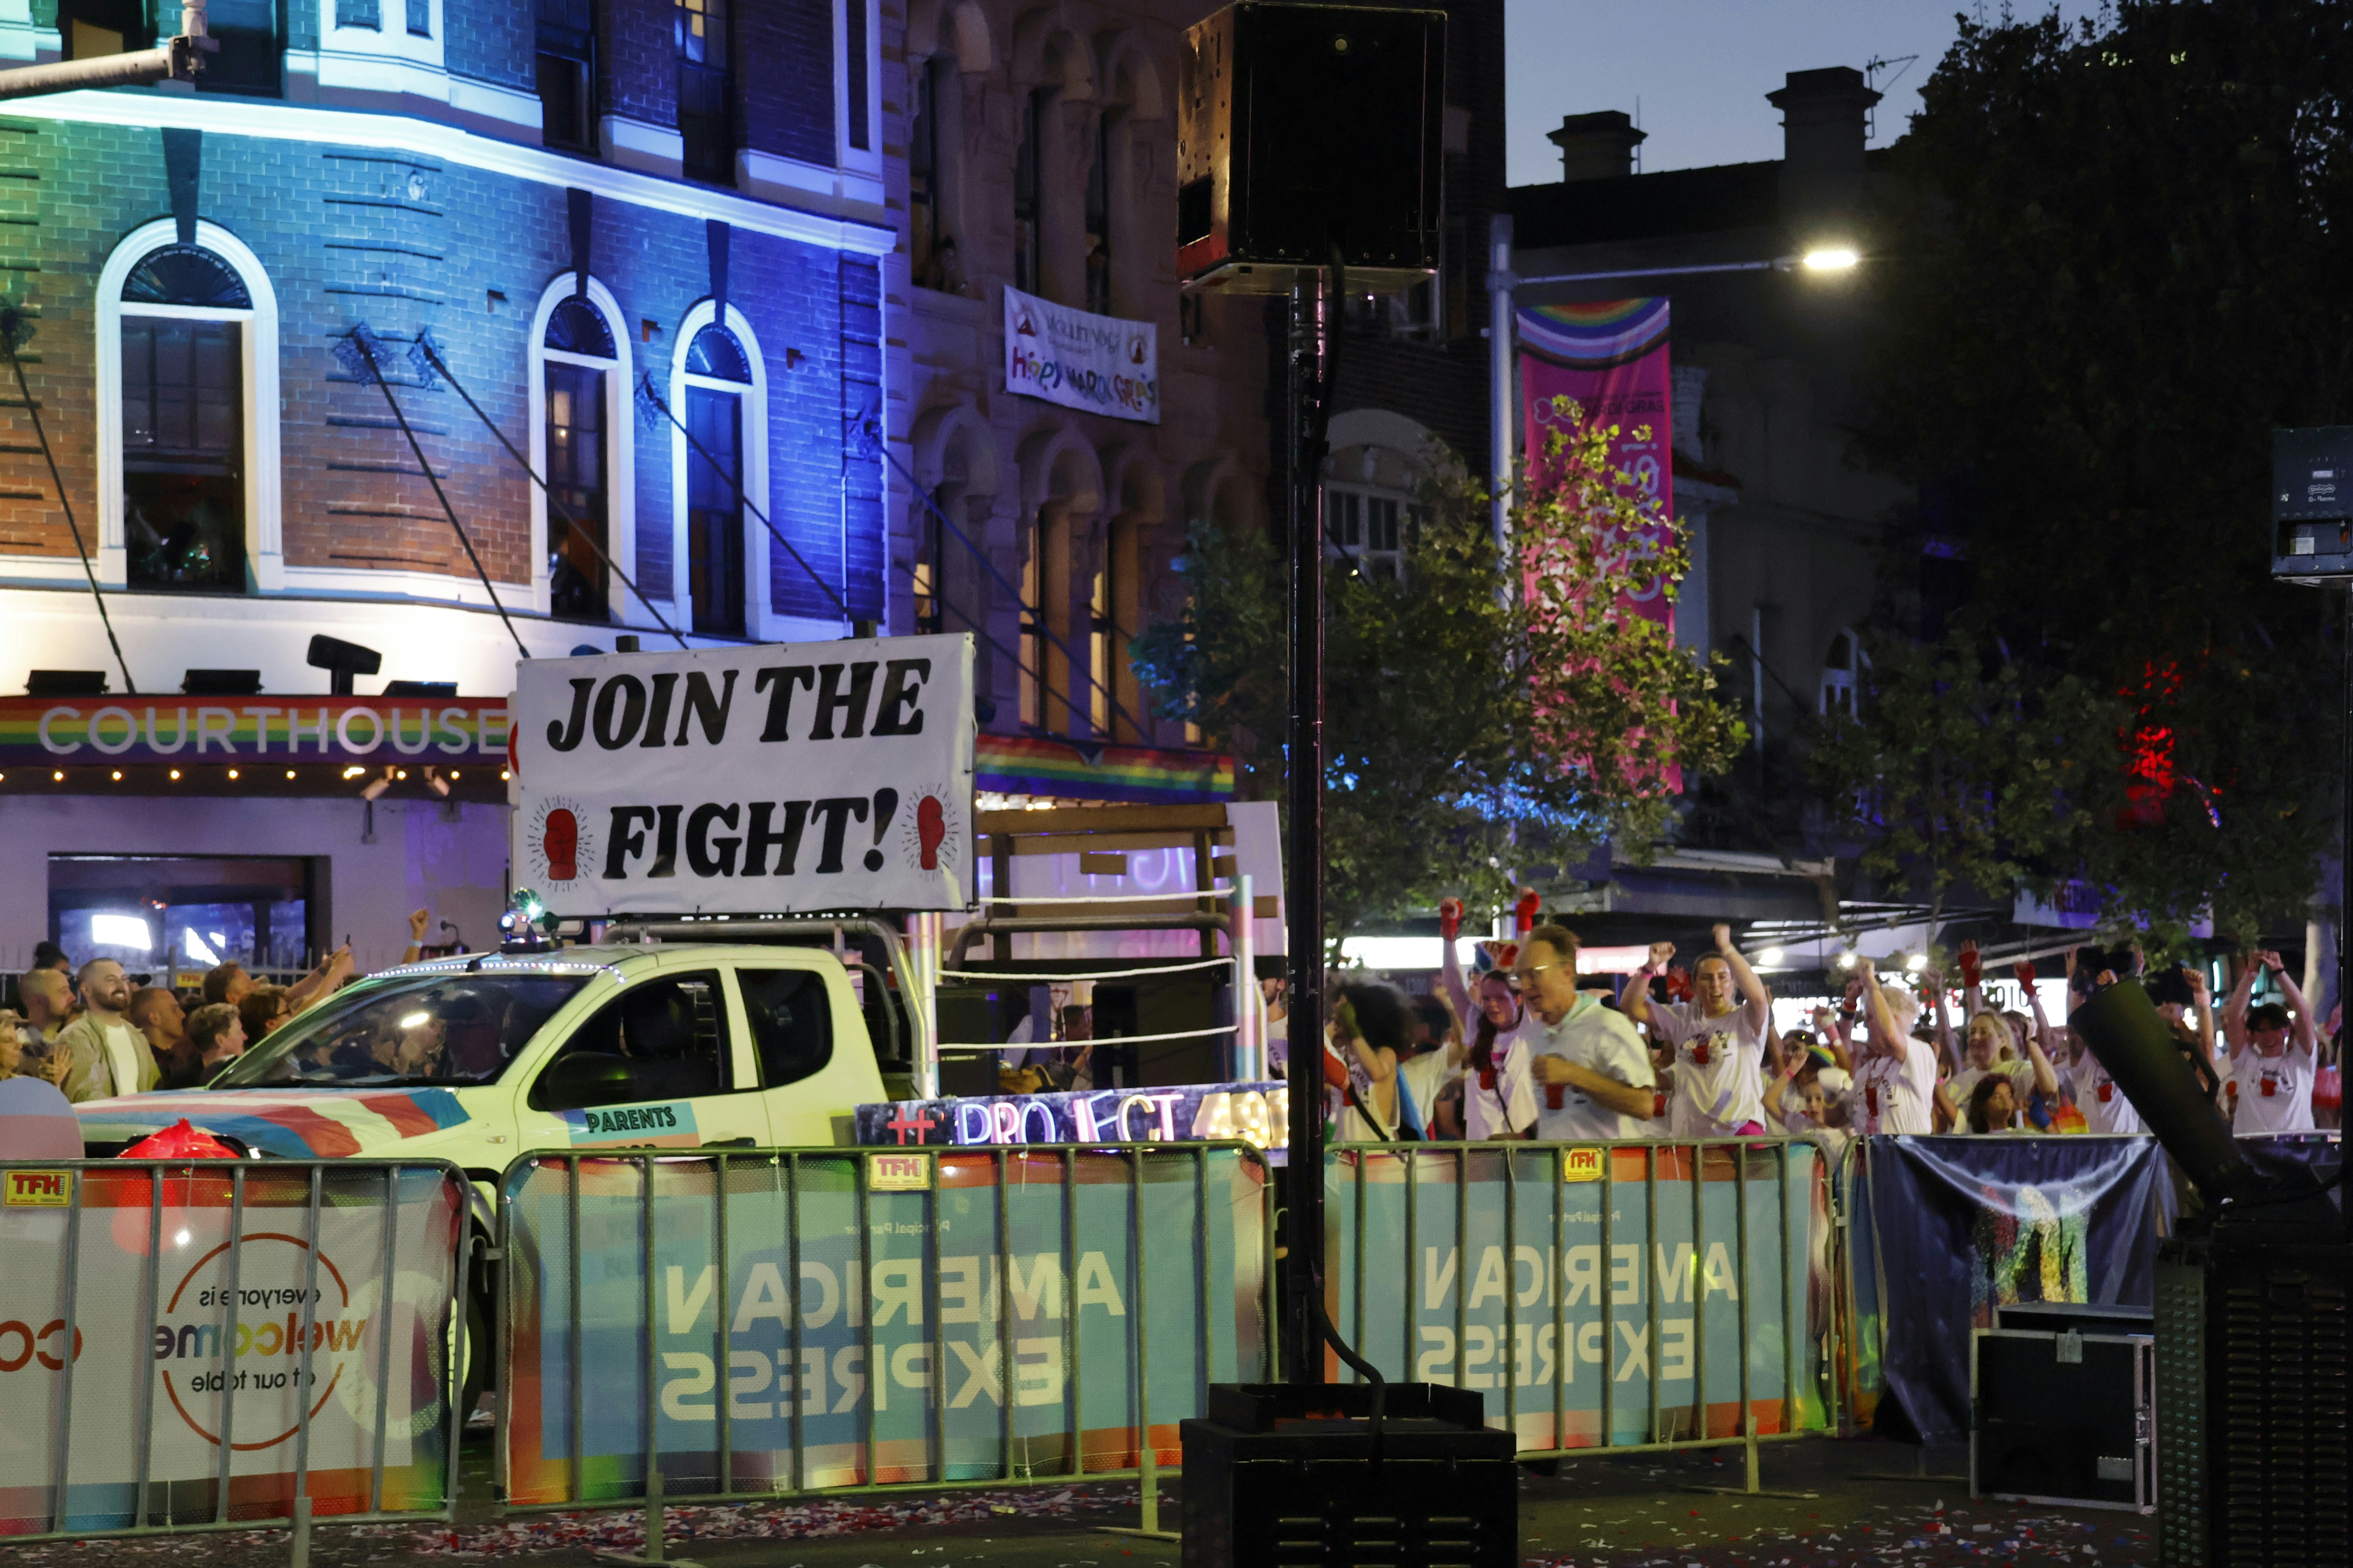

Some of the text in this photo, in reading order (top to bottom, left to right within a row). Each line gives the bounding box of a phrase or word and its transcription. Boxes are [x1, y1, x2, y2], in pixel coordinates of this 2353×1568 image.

[547, 659, 931, 752] JOIN THE
[37, 705, 508, 755] COURTHOUSE
[602, 787, 899, 880] FIGHT!
[586, 1106, 676, 1133] PARENTS
[878, 1158, 918, 1176] TFH
[1571, 1152, 1595, 1168] TFH
[13, 1175, 60, 1194] TFH
